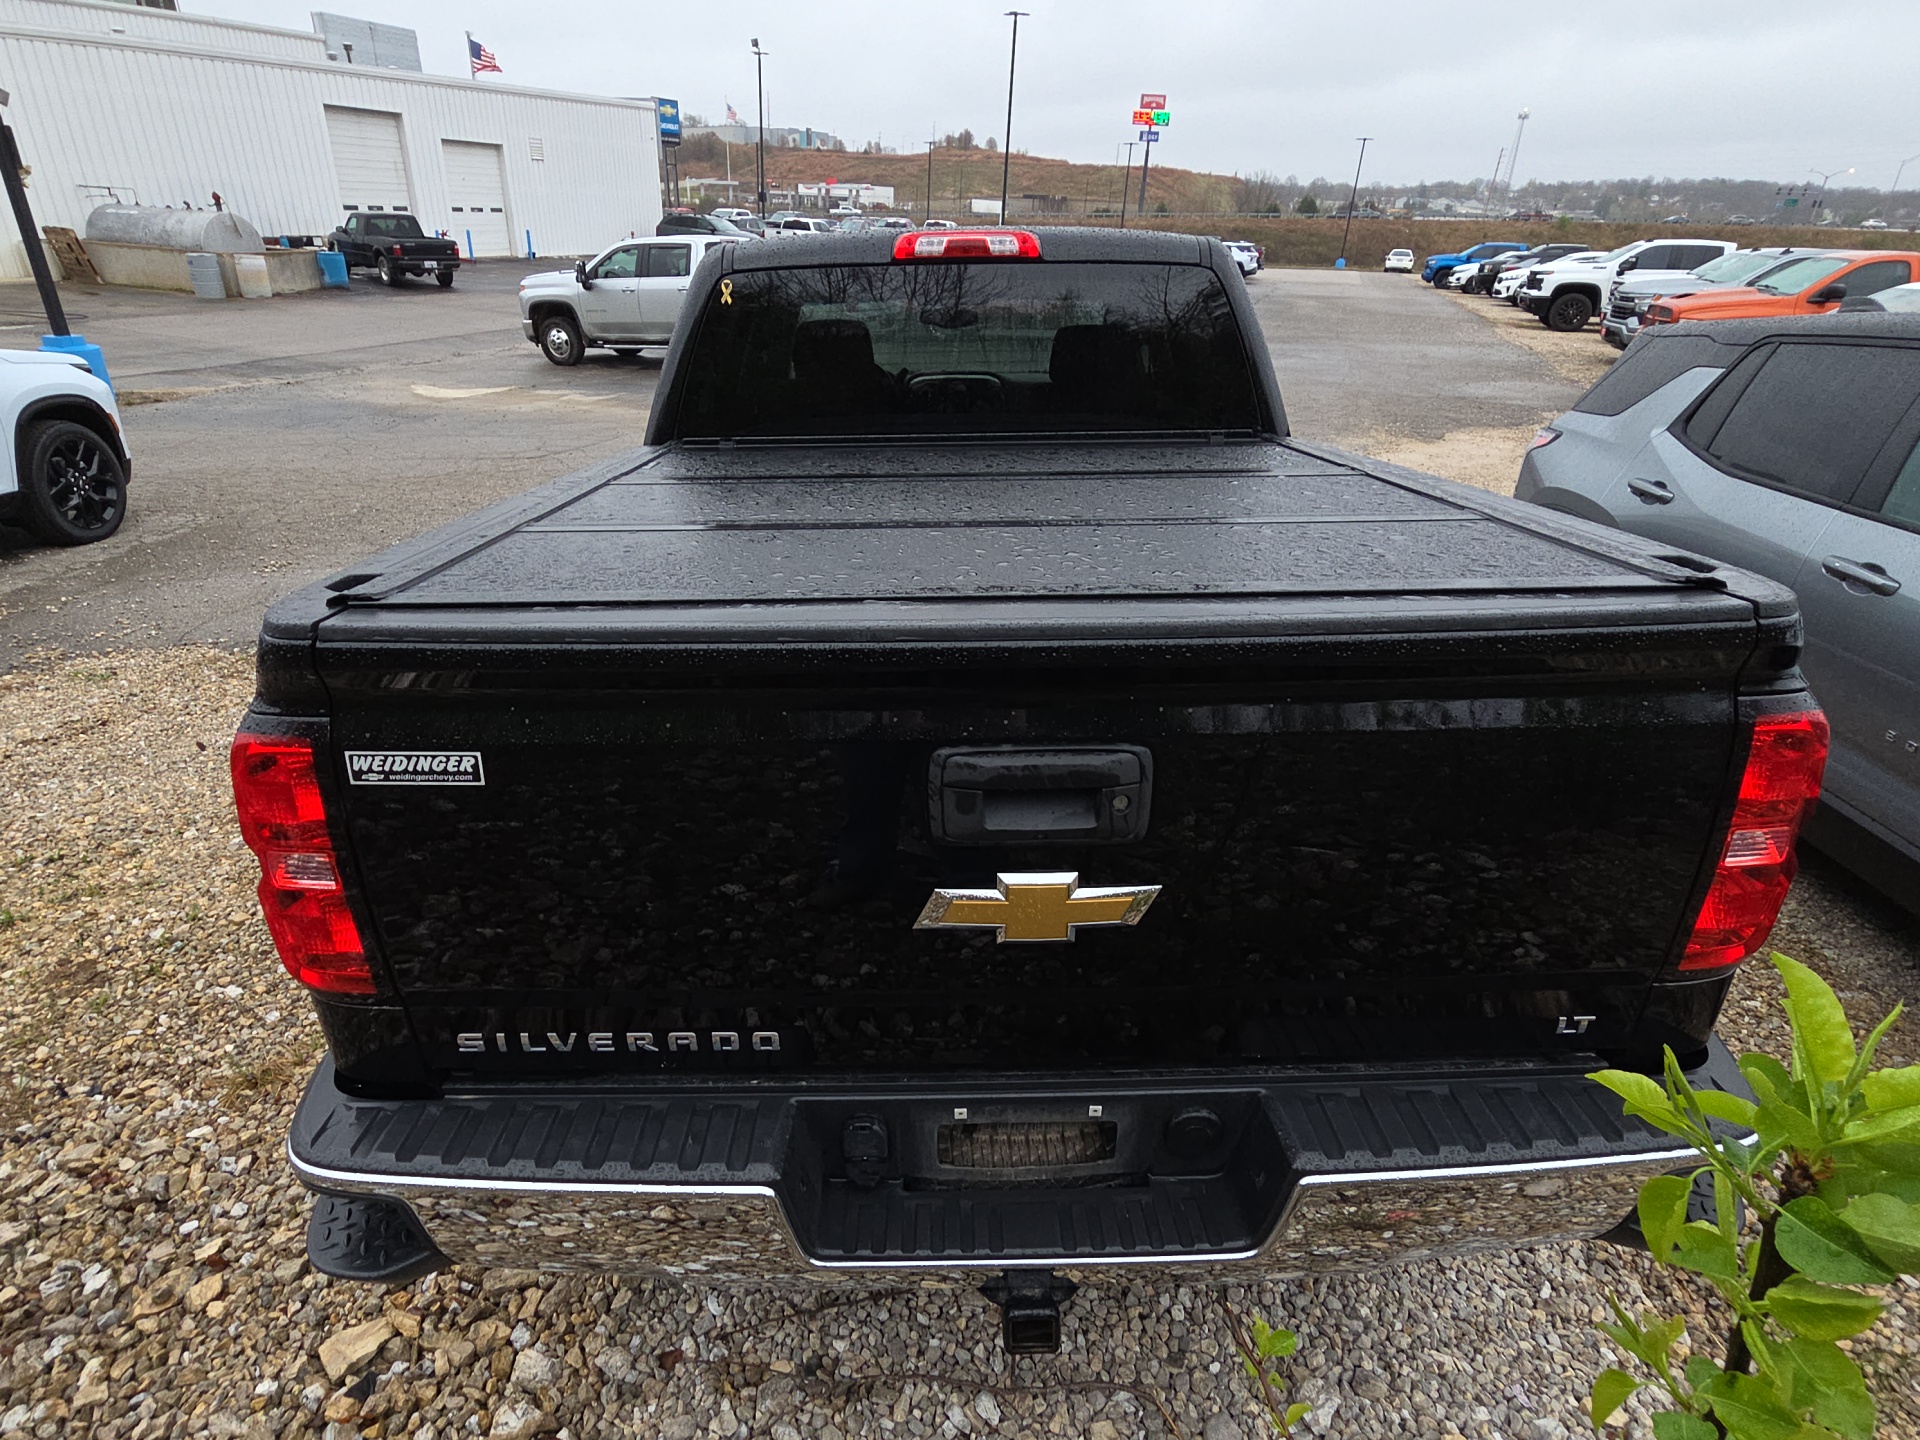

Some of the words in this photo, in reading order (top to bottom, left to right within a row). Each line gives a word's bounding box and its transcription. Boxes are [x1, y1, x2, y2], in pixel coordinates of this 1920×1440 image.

[352, 755, 476, 772] WEIDINGER
[389, 773, 473, 782] weidingerchevy.com
[1556, 1016, 1597, 1034] LT
[456, 1031, 781, 1052] SILVERADO
